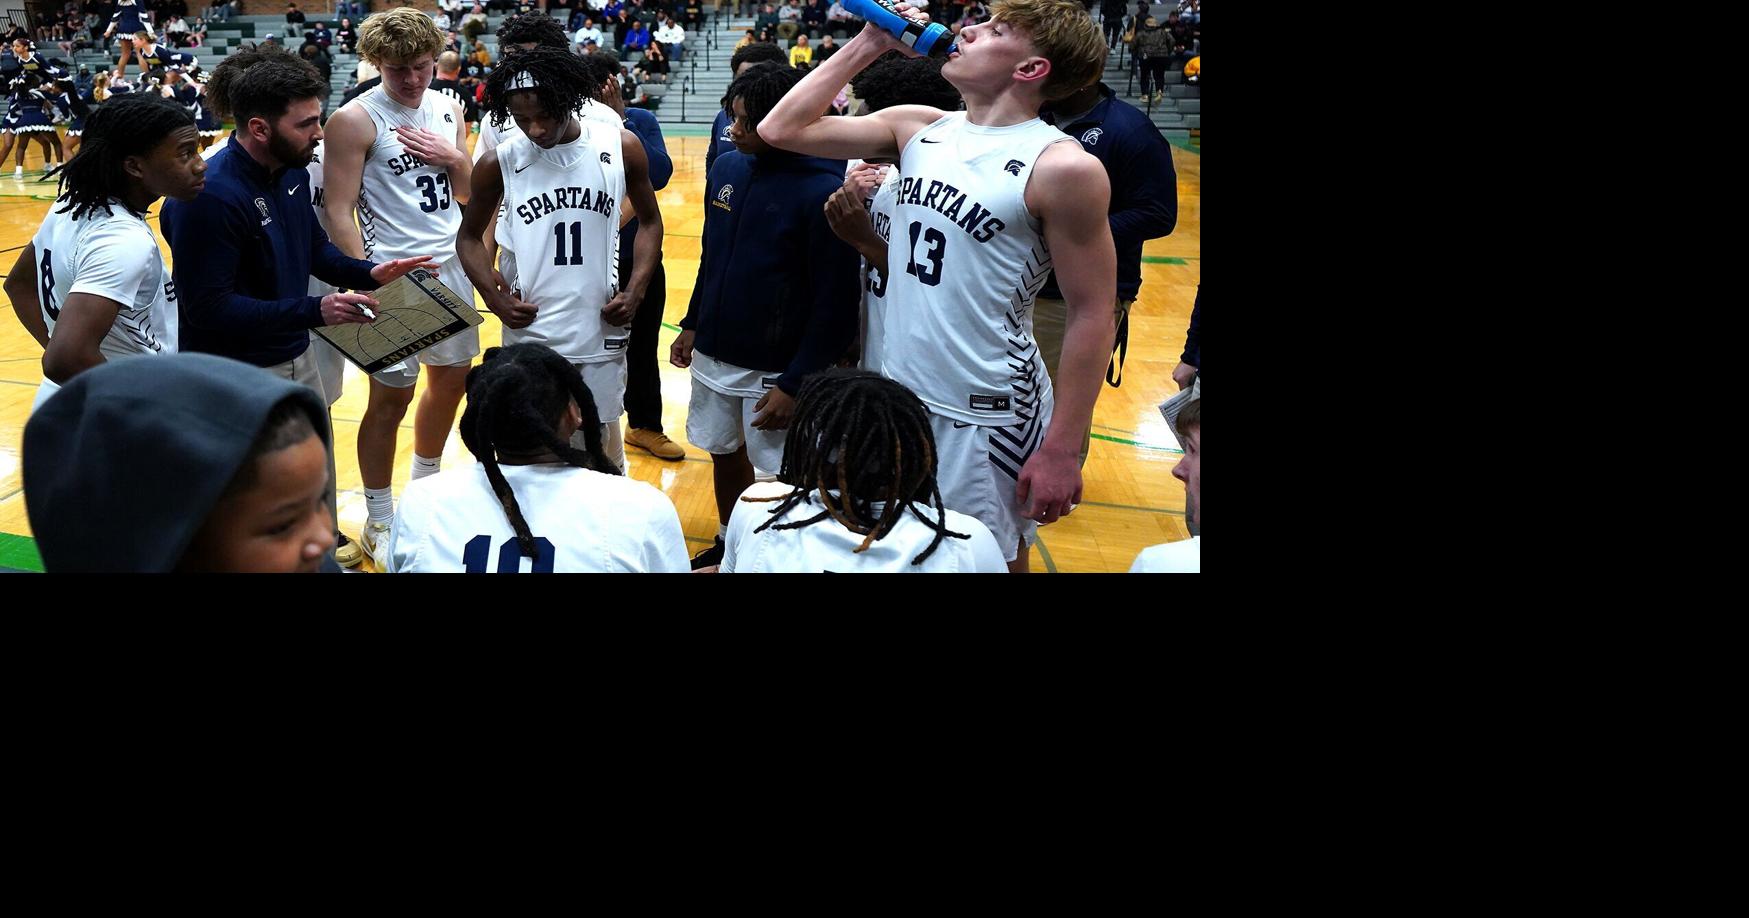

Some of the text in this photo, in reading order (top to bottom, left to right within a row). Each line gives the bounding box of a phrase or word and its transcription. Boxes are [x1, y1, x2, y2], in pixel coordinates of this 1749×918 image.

[416, 172, 451, 213] 33
[517, 187, 615, 225] SPARTANS
[554, 222, 583, 266] 11
[906, 221, 946, 287] 13
[431, 287, 461, 309] VARSITY
[381, 329, 451, 365] SPARTANS
